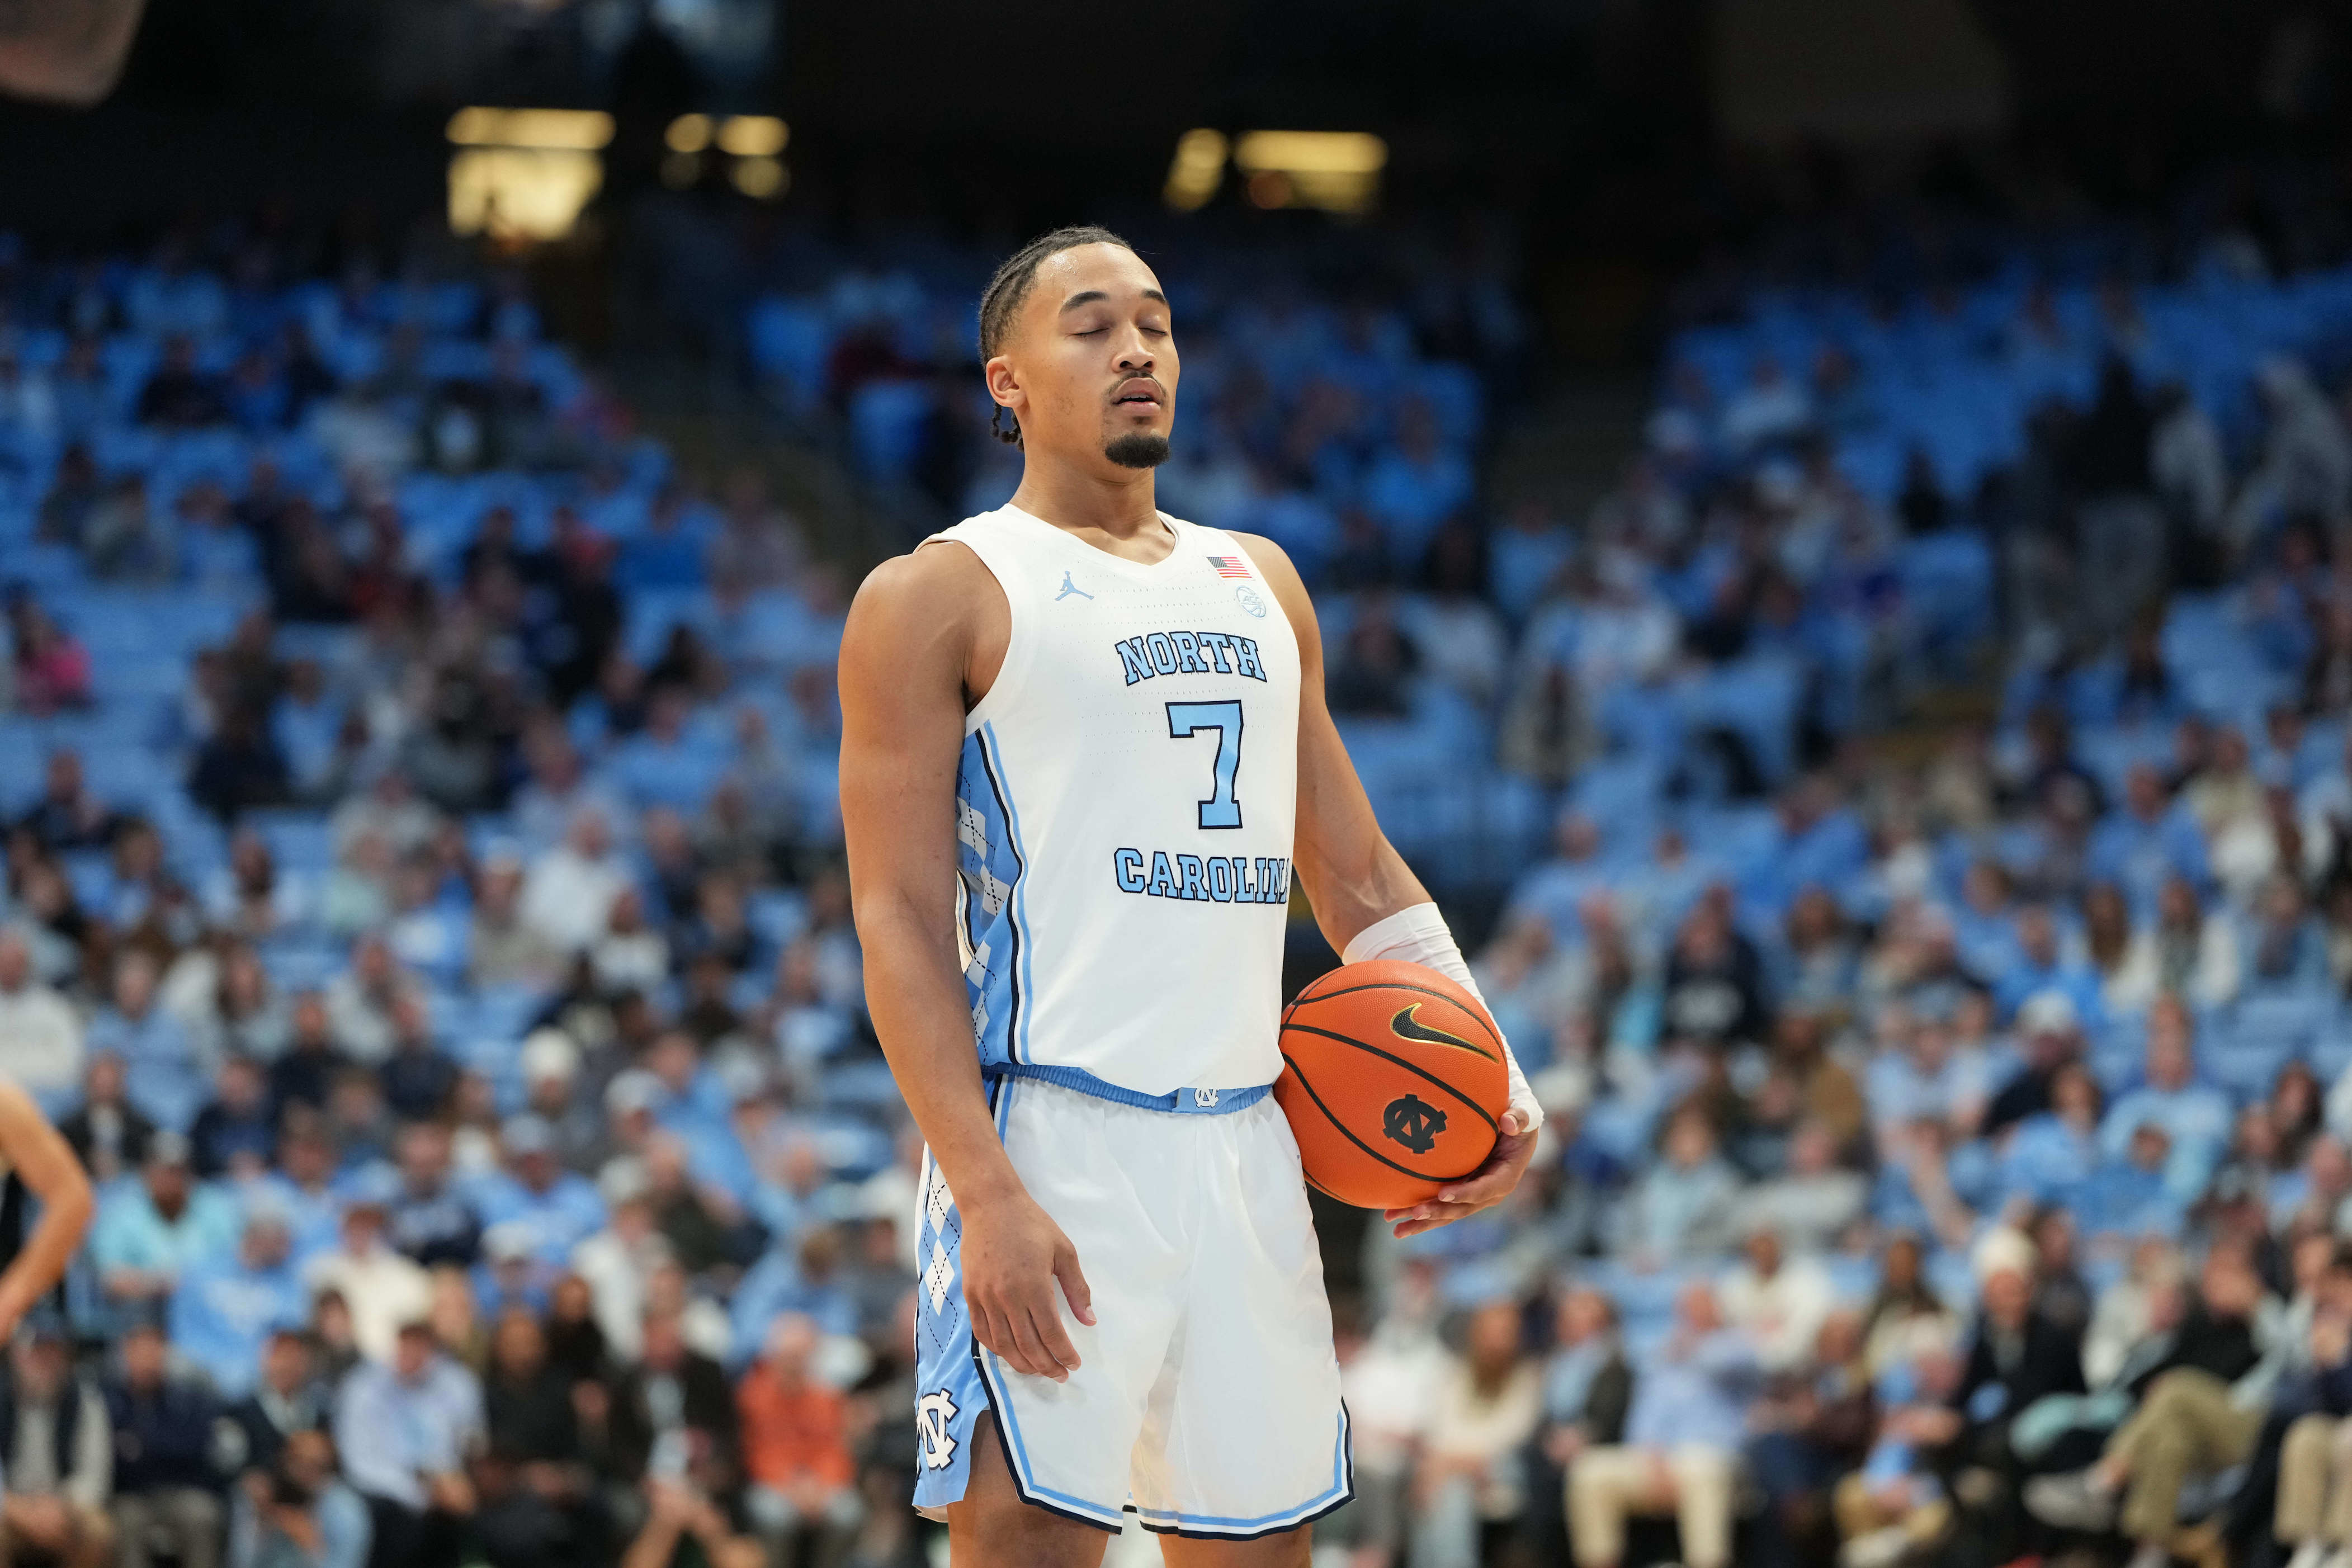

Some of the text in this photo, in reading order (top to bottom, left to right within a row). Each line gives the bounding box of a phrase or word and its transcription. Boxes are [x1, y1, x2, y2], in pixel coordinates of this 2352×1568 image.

[1114, 631, 1267, 686] NORTH
[1165, 700, 1244, 829] 7
[1114, 847, 1289, 904] CAROLIN
